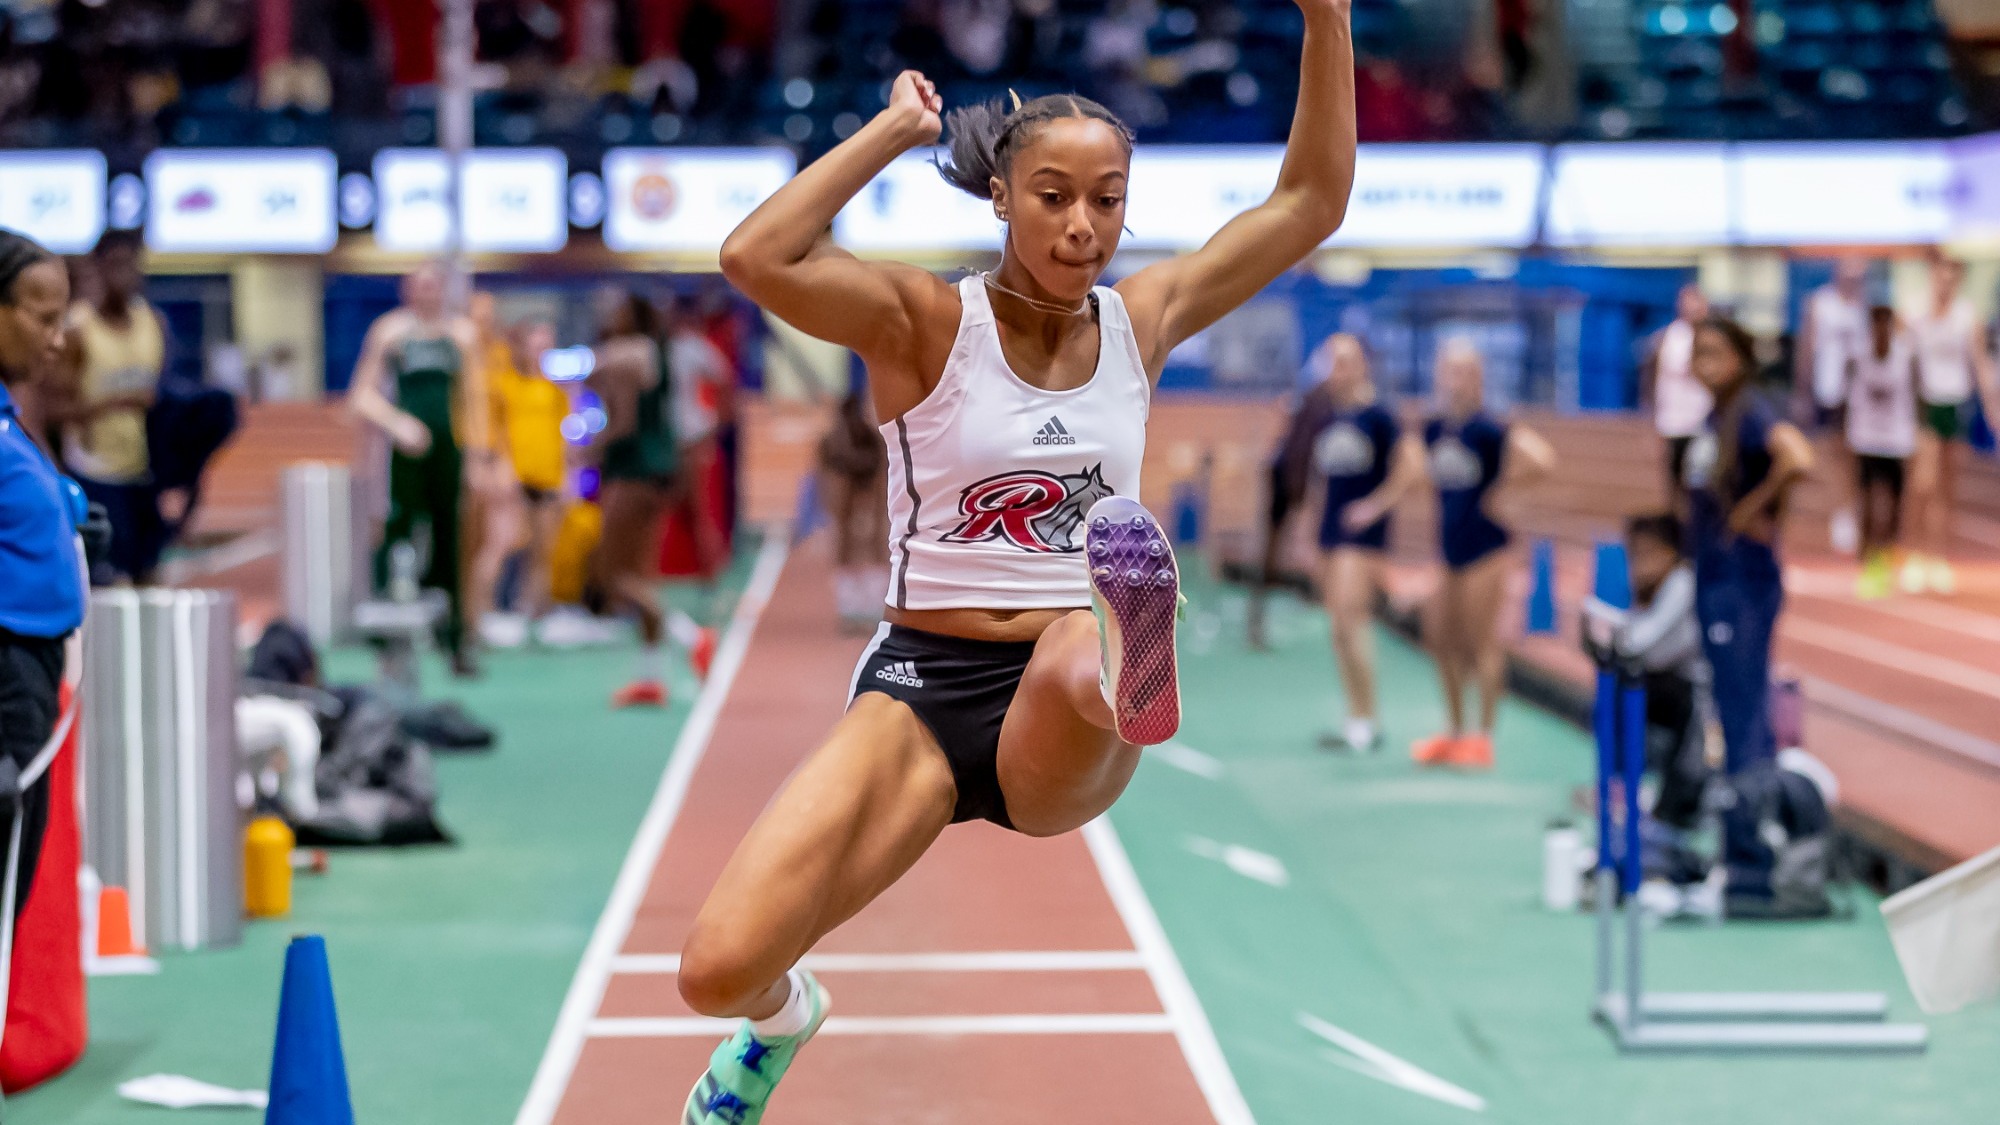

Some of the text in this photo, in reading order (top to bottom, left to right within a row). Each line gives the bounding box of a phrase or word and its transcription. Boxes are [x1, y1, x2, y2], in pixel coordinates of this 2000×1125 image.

[1032, 433, 1076, 445] adidas
[937, 469, 1070, 553] R
[876, 669, 924, 688] adidas
